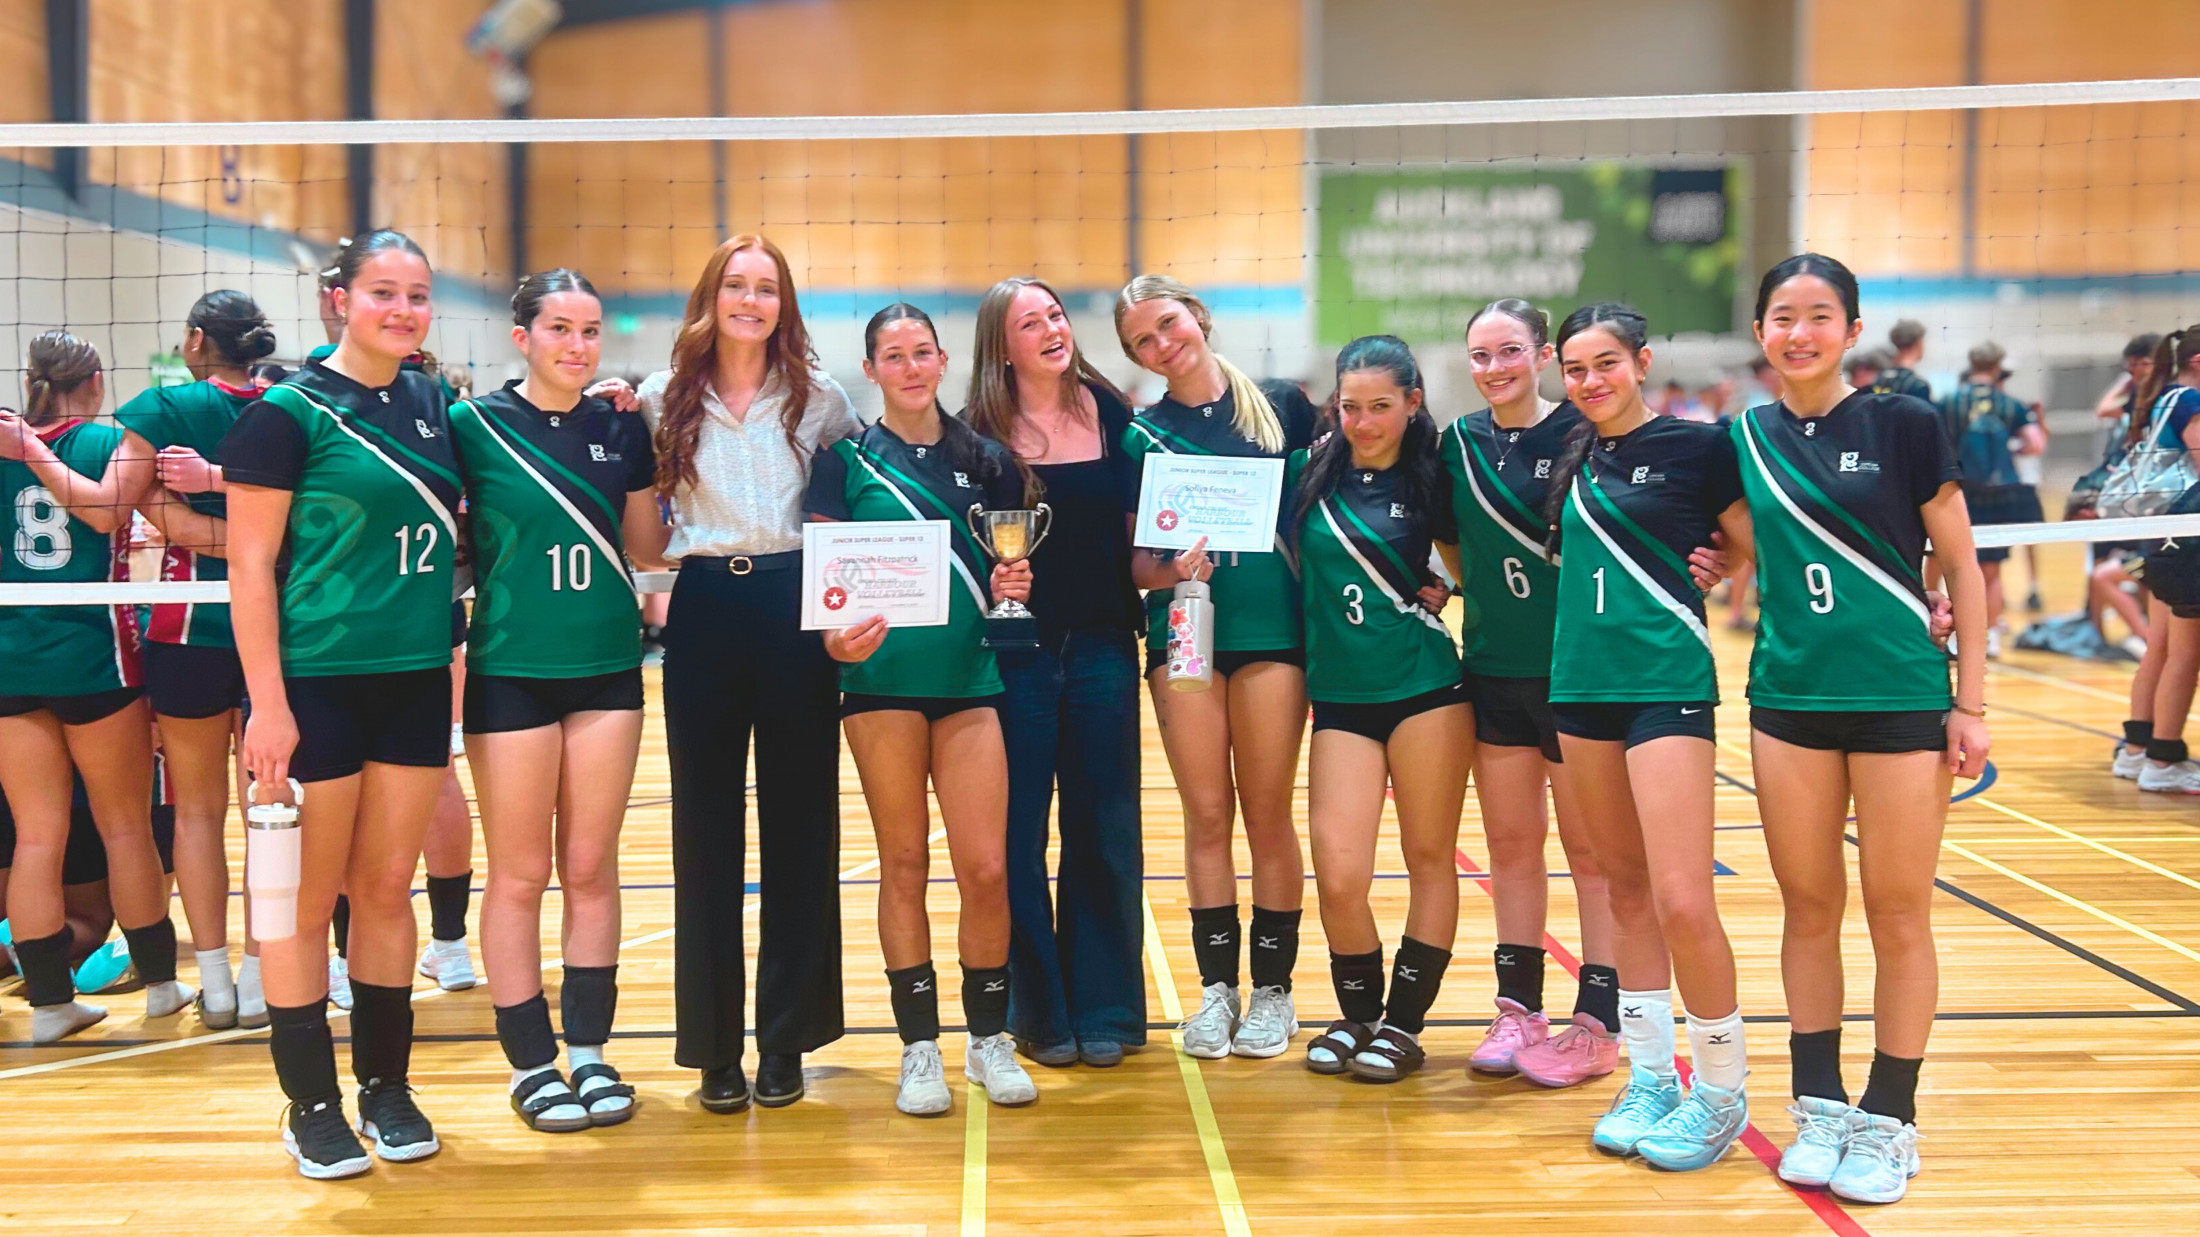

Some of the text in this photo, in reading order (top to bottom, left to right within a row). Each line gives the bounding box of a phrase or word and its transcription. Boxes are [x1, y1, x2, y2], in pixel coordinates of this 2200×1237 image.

[14, 485, 72, 570] 8
[394, 522, 438, 576] 12
[546, 543, 592, 592] 10
[1503, 556, 1531, 599] 6
[1592, 567, 1605, 614] 1
[1805, 562, 1835, 614] 9
[1342, 583, 1365, 625] 3
